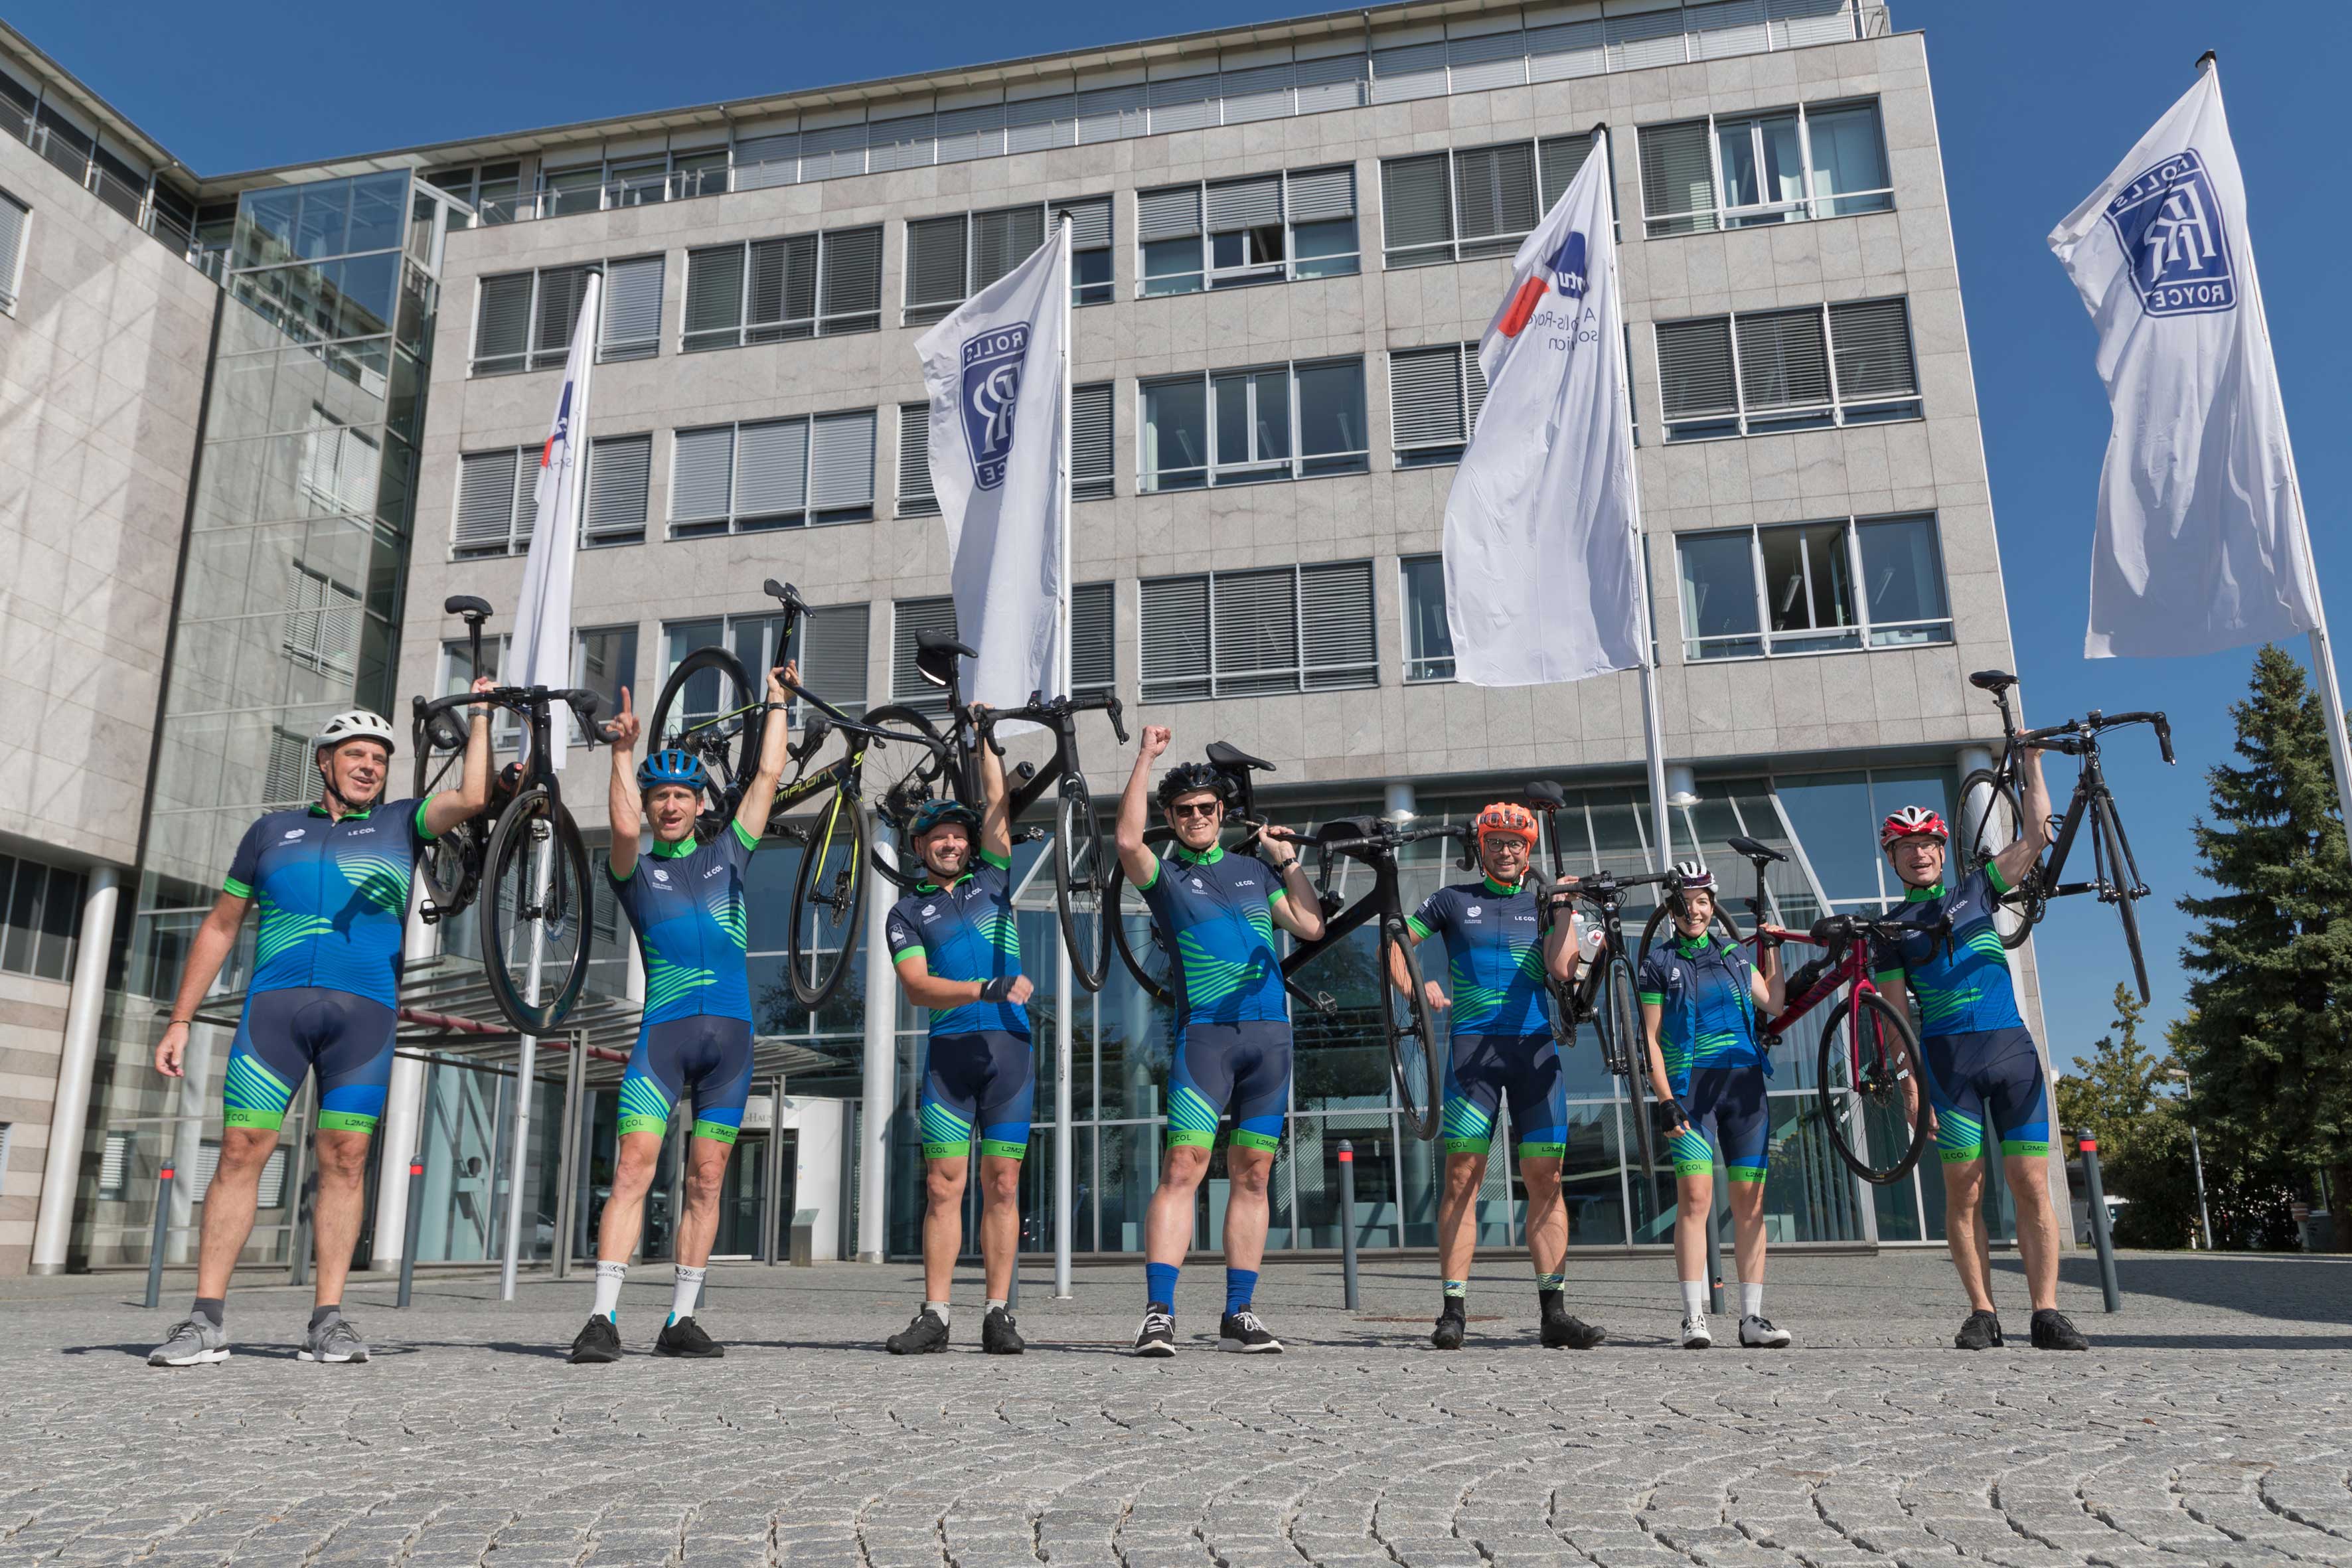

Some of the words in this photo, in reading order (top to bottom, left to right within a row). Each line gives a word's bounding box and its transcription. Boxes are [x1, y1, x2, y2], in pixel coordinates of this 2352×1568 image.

[711, 864, 723, 875] COL
[1956, 899, 1968, 909] COL
[231, 1113, 250, 1122] COL
[625, 1119, 644, 1127] COL
